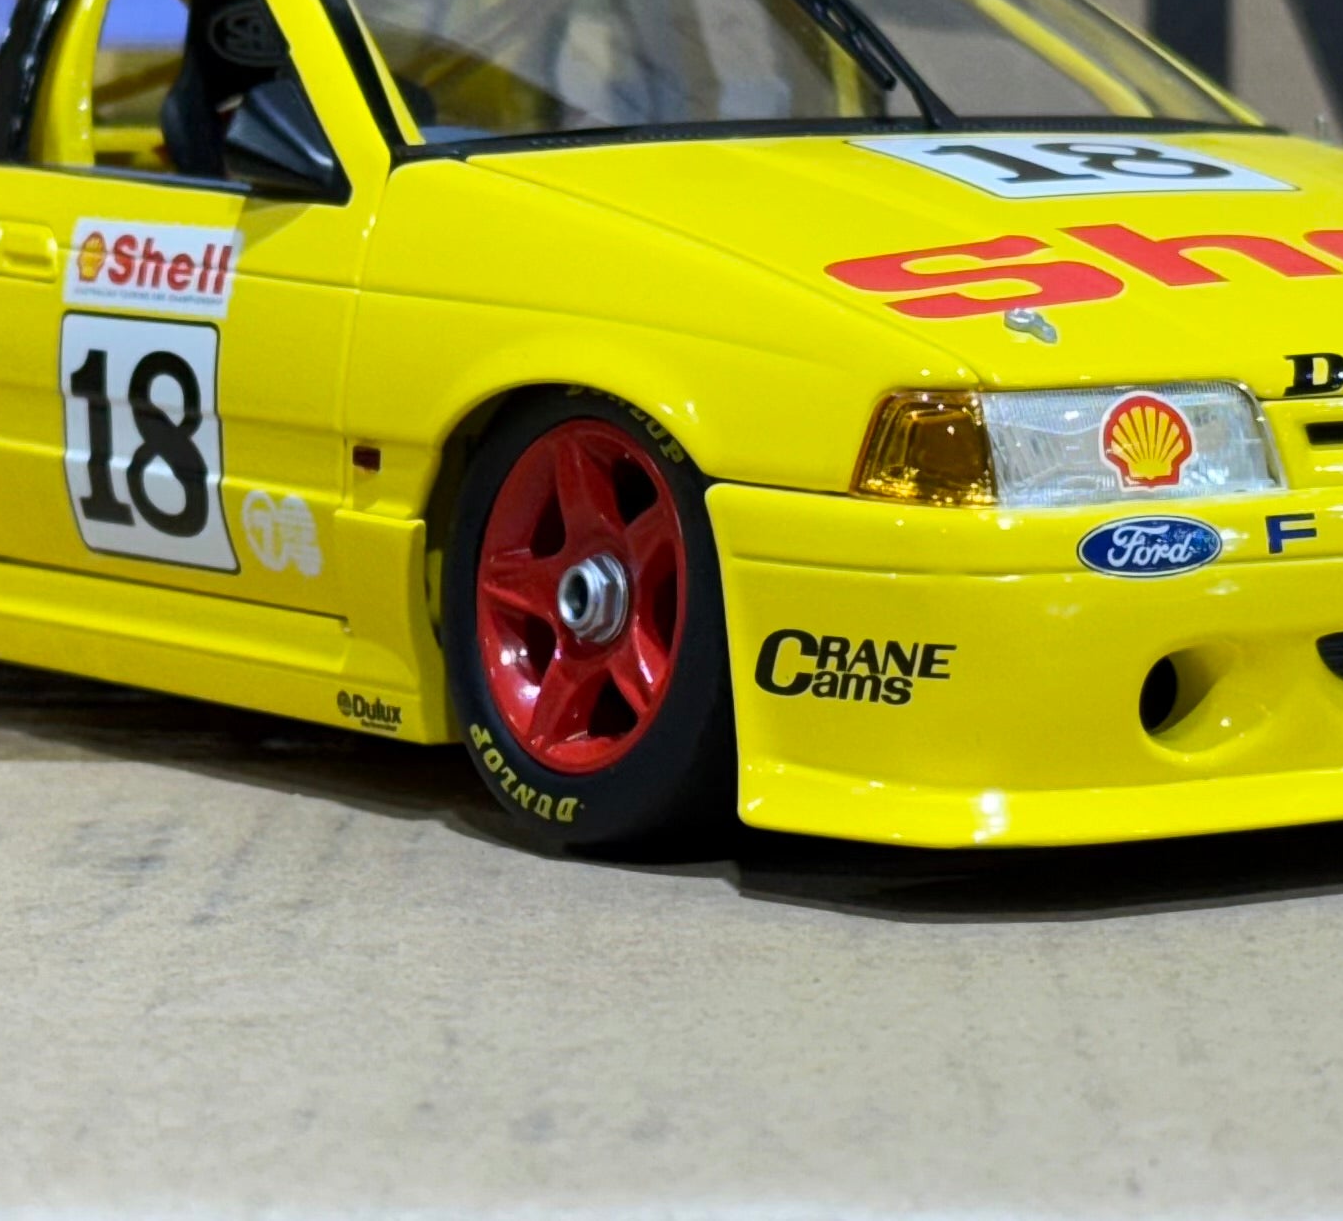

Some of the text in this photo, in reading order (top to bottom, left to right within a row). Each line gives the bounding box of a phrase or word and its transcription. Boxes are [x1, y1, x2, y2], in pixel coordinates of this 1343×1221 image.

[926, 139, 1232, 185] 18
[108, 234, 233, 295] Shell
[70, 348, 210, 539] 18
[1107, 524, 1194, 567] Ford
[755, 629, 957, 696] CRANE
[352, 693, 403, 724] Dulux
[469, 723, 578, 822] DUNLOP
